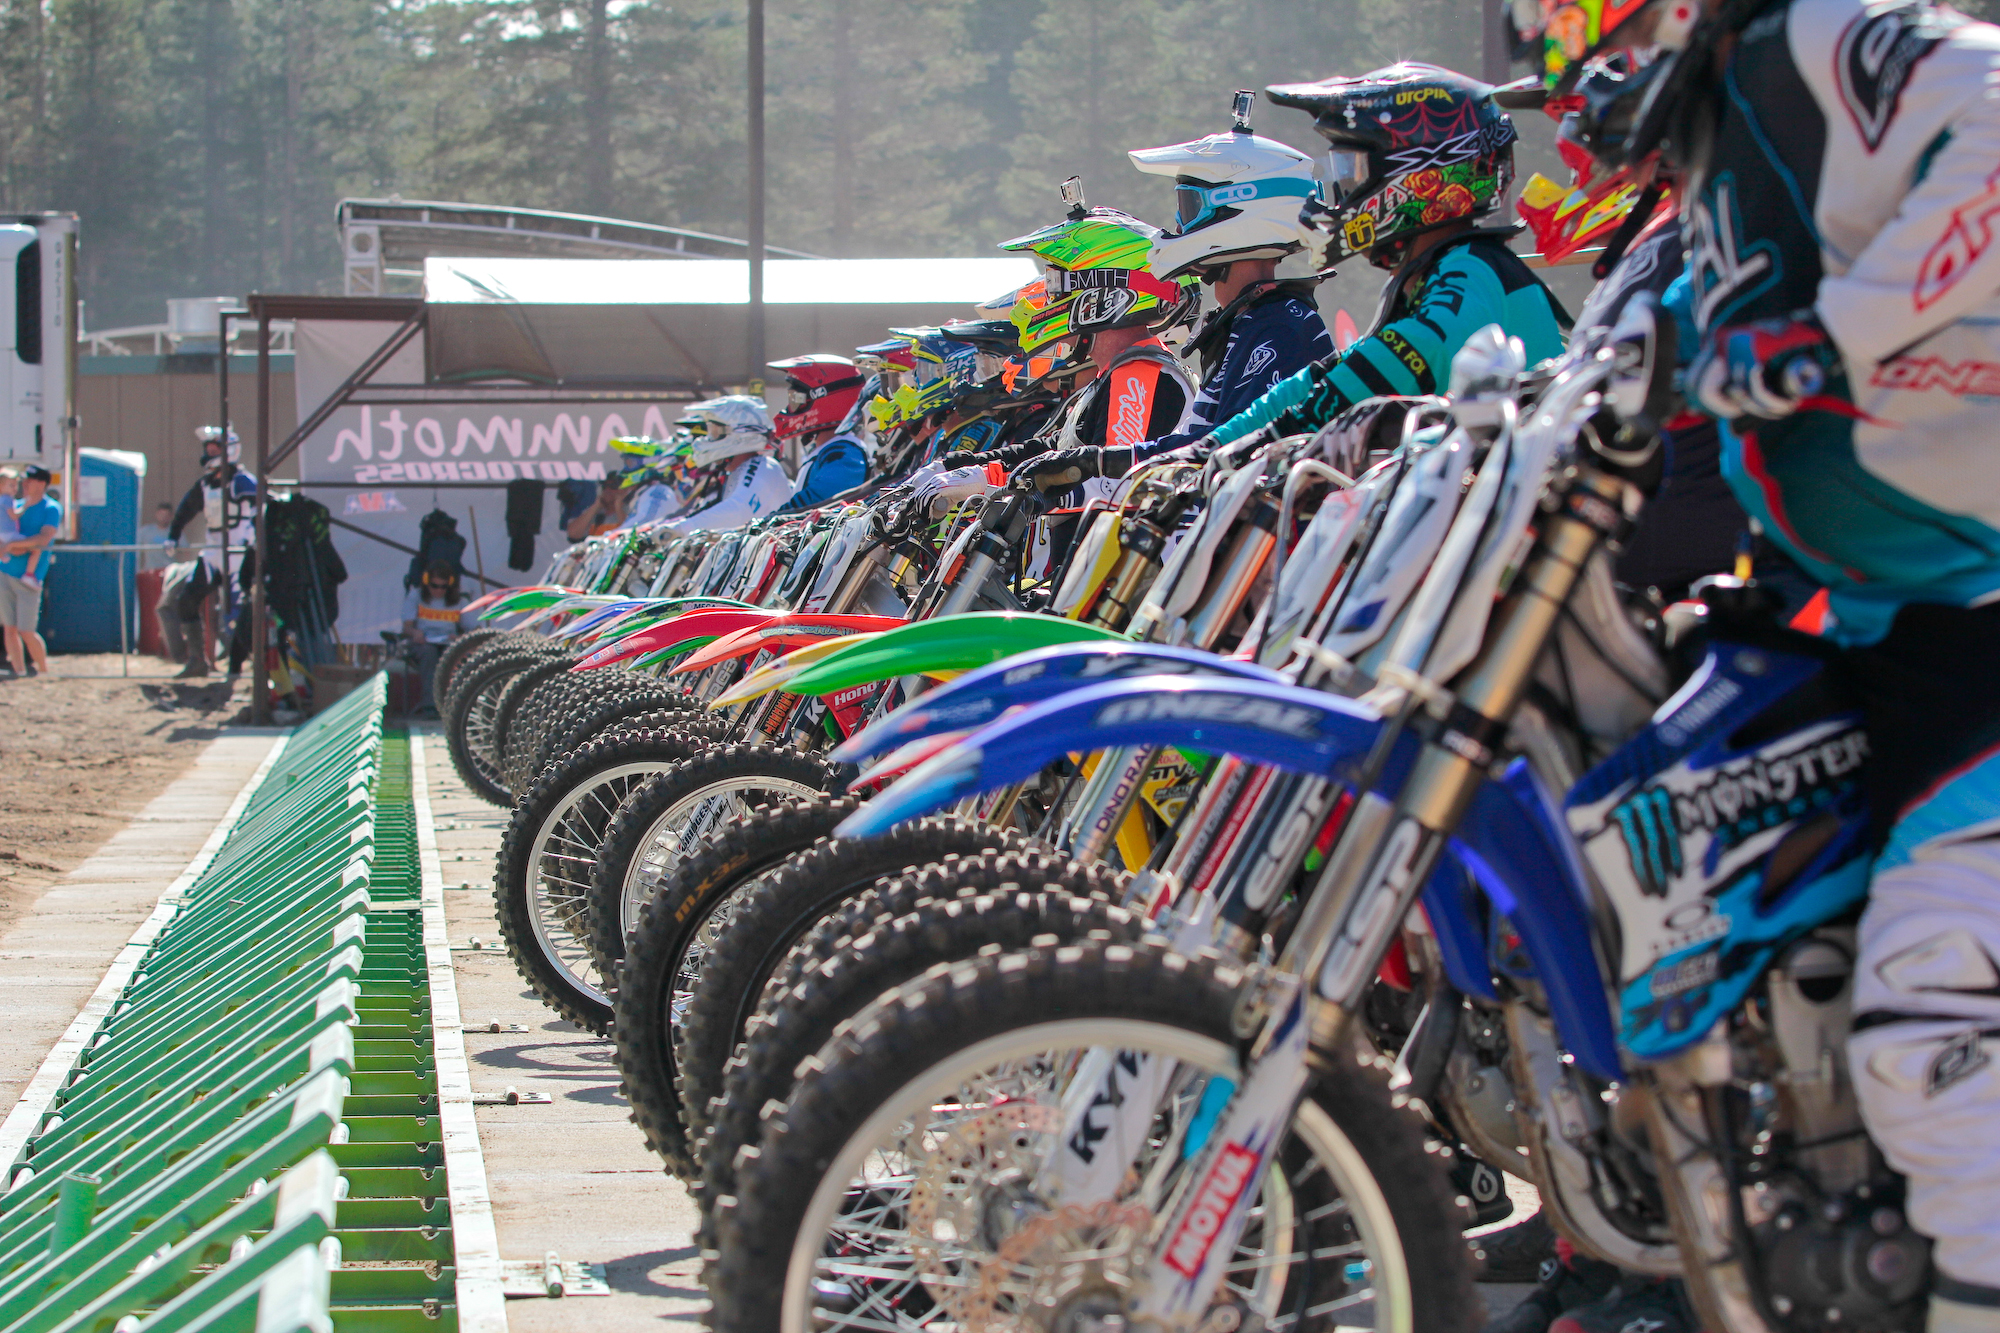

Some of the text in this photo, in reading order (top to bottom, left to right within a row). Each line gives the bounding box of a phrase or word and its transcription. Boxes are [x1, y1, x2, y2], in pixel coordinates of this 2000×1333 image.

[1069, 269, 1130, 290] SMITH
[790, 782, 819, 798] EXCEL
[1096, 783, 1130, 833] DINO
[1677, 732, 1870, 835] MONSTER
[1168, 1142, 1258, 1275] MOTUL
